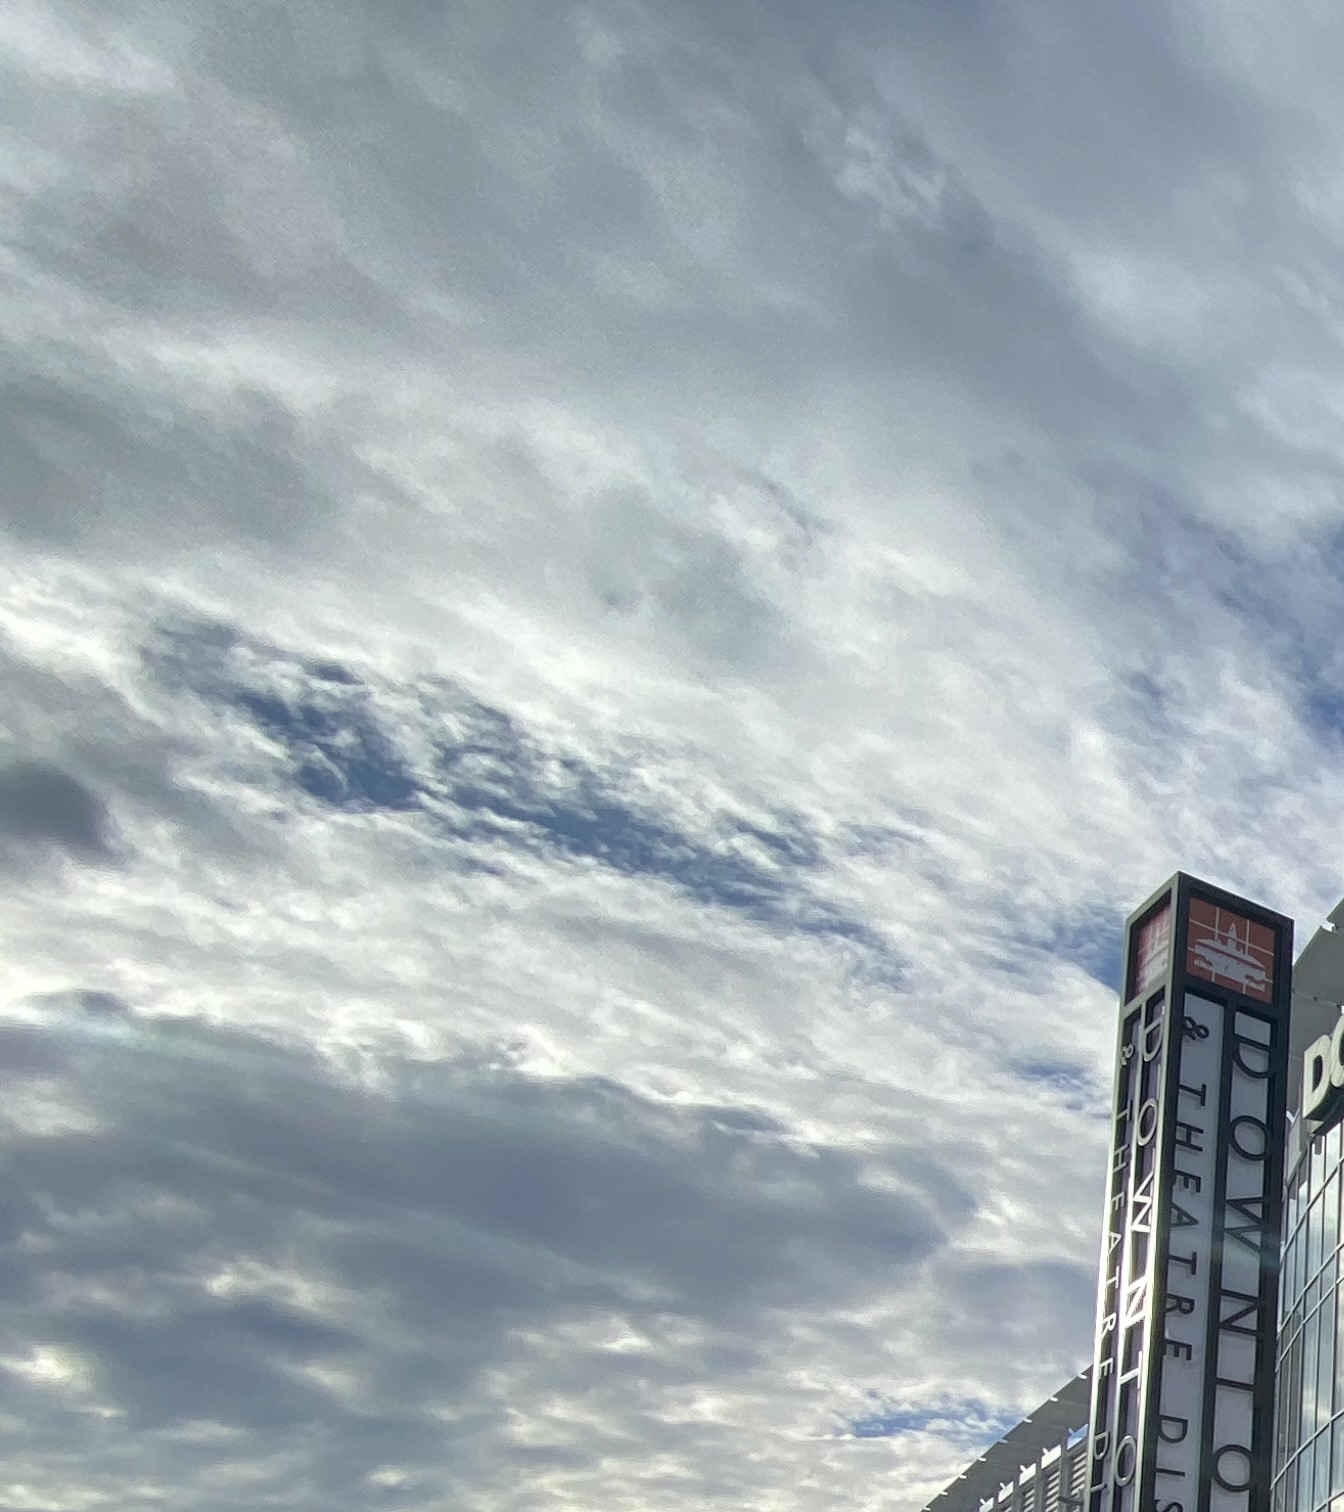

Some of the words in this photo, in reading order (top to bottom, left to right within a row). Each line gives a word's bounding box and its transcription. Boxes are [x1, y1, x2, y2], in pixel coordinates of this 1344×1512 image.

[1182, 1015, 1209, 1042] &
[1098, 1098, 1132, 1378] THEATRE
[1163, 1082, 1207, 1362] THEATRE
